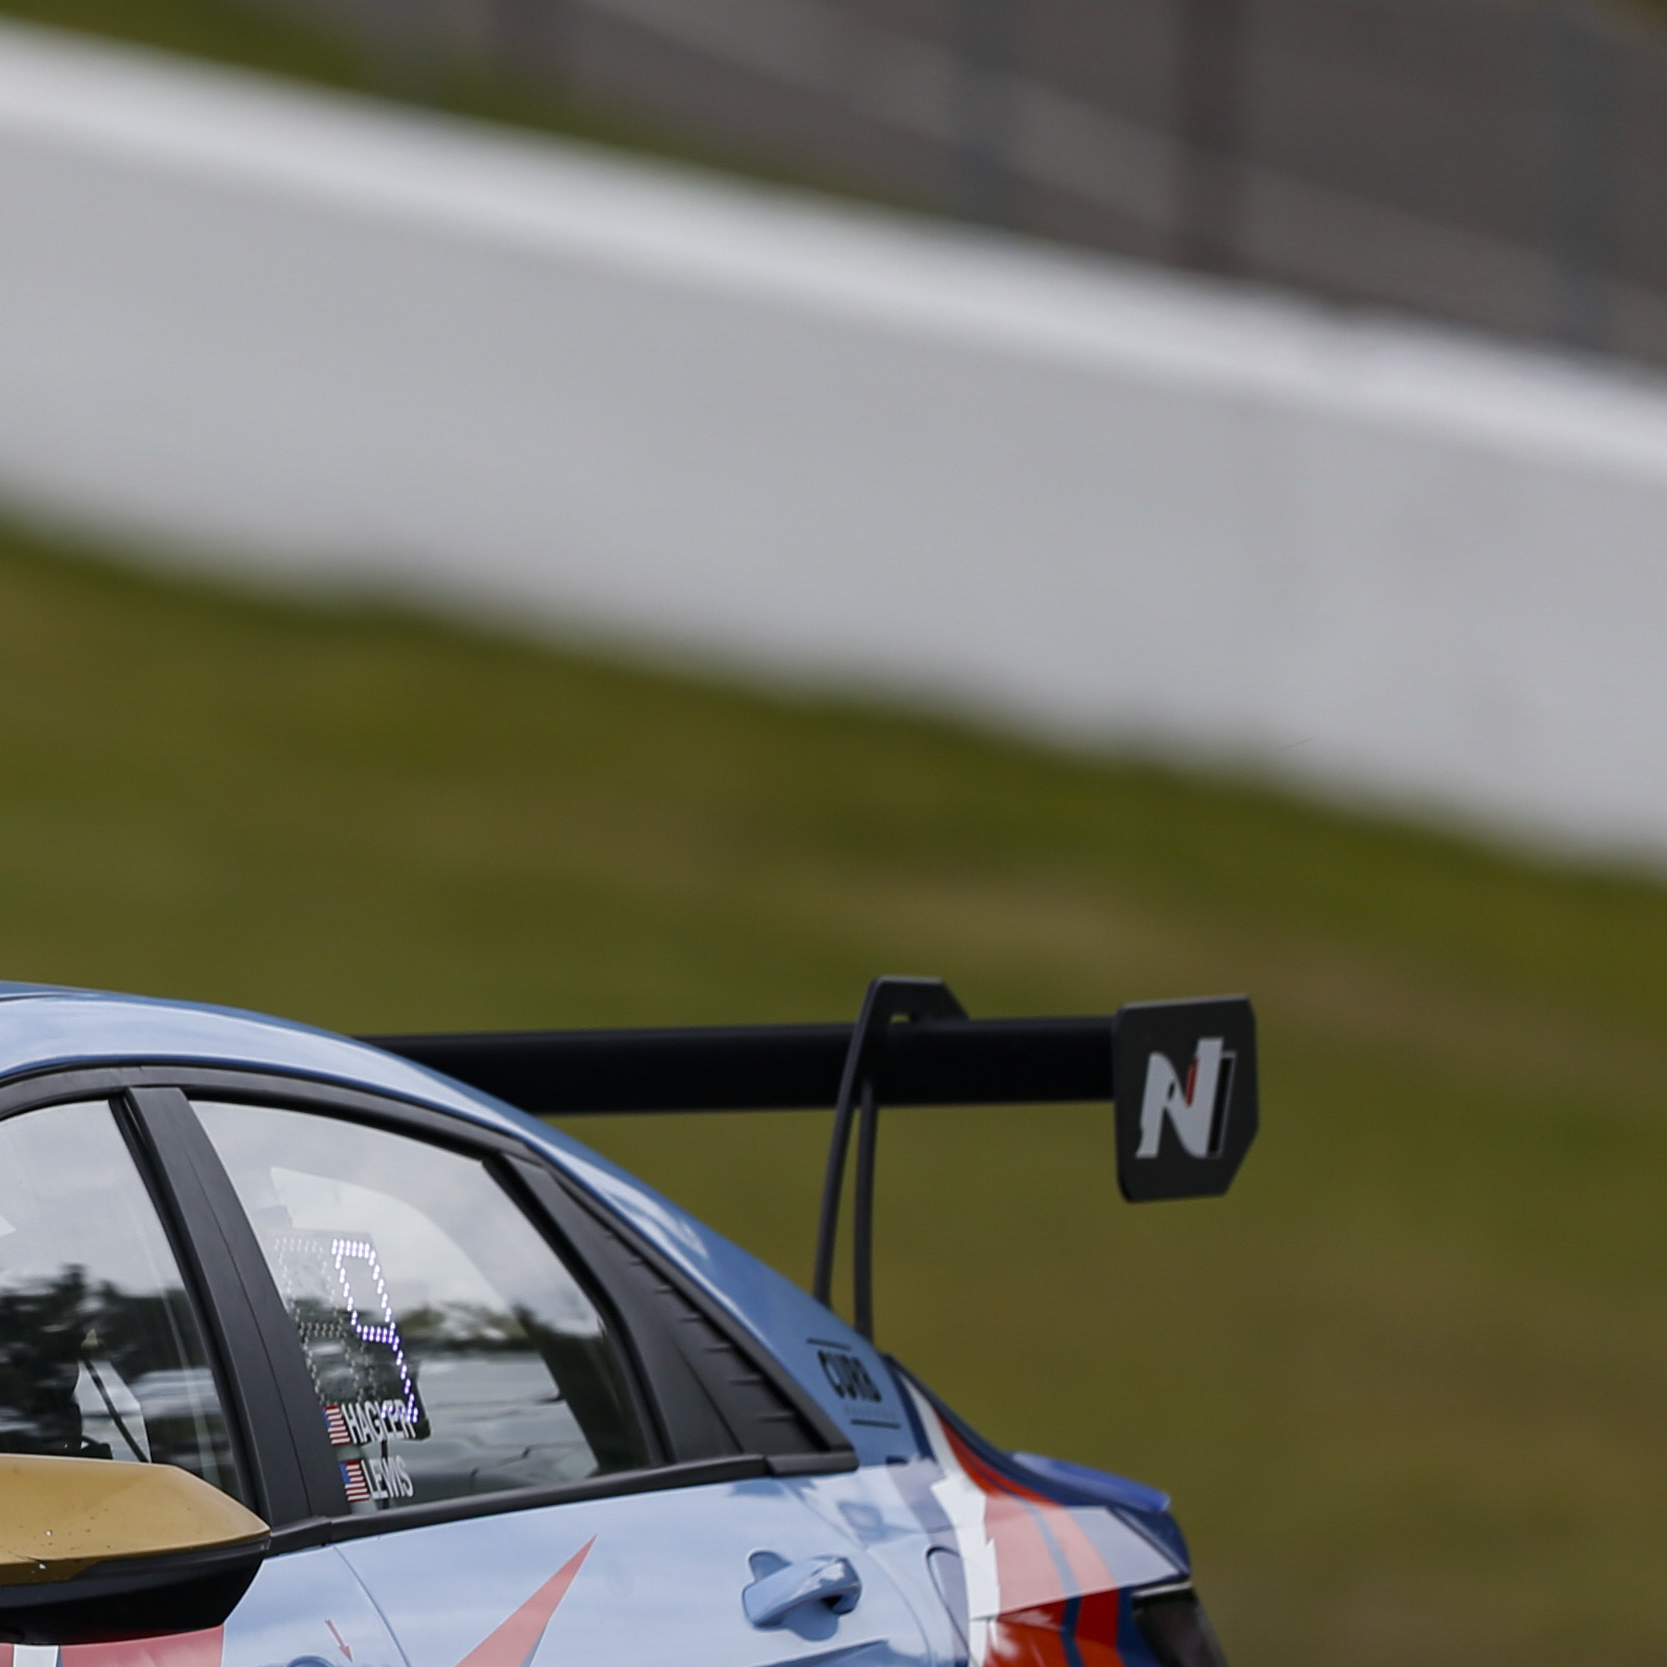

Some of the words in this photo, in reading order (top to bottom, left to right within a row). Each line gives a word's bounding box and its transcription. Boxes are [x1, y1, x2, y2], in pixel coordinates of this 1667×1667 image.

[1135, 1037, 1237, 1159] N
[340, 1399, 417, 1445] HAGLER
[360, 1455, 415, 1500] LEWIS
